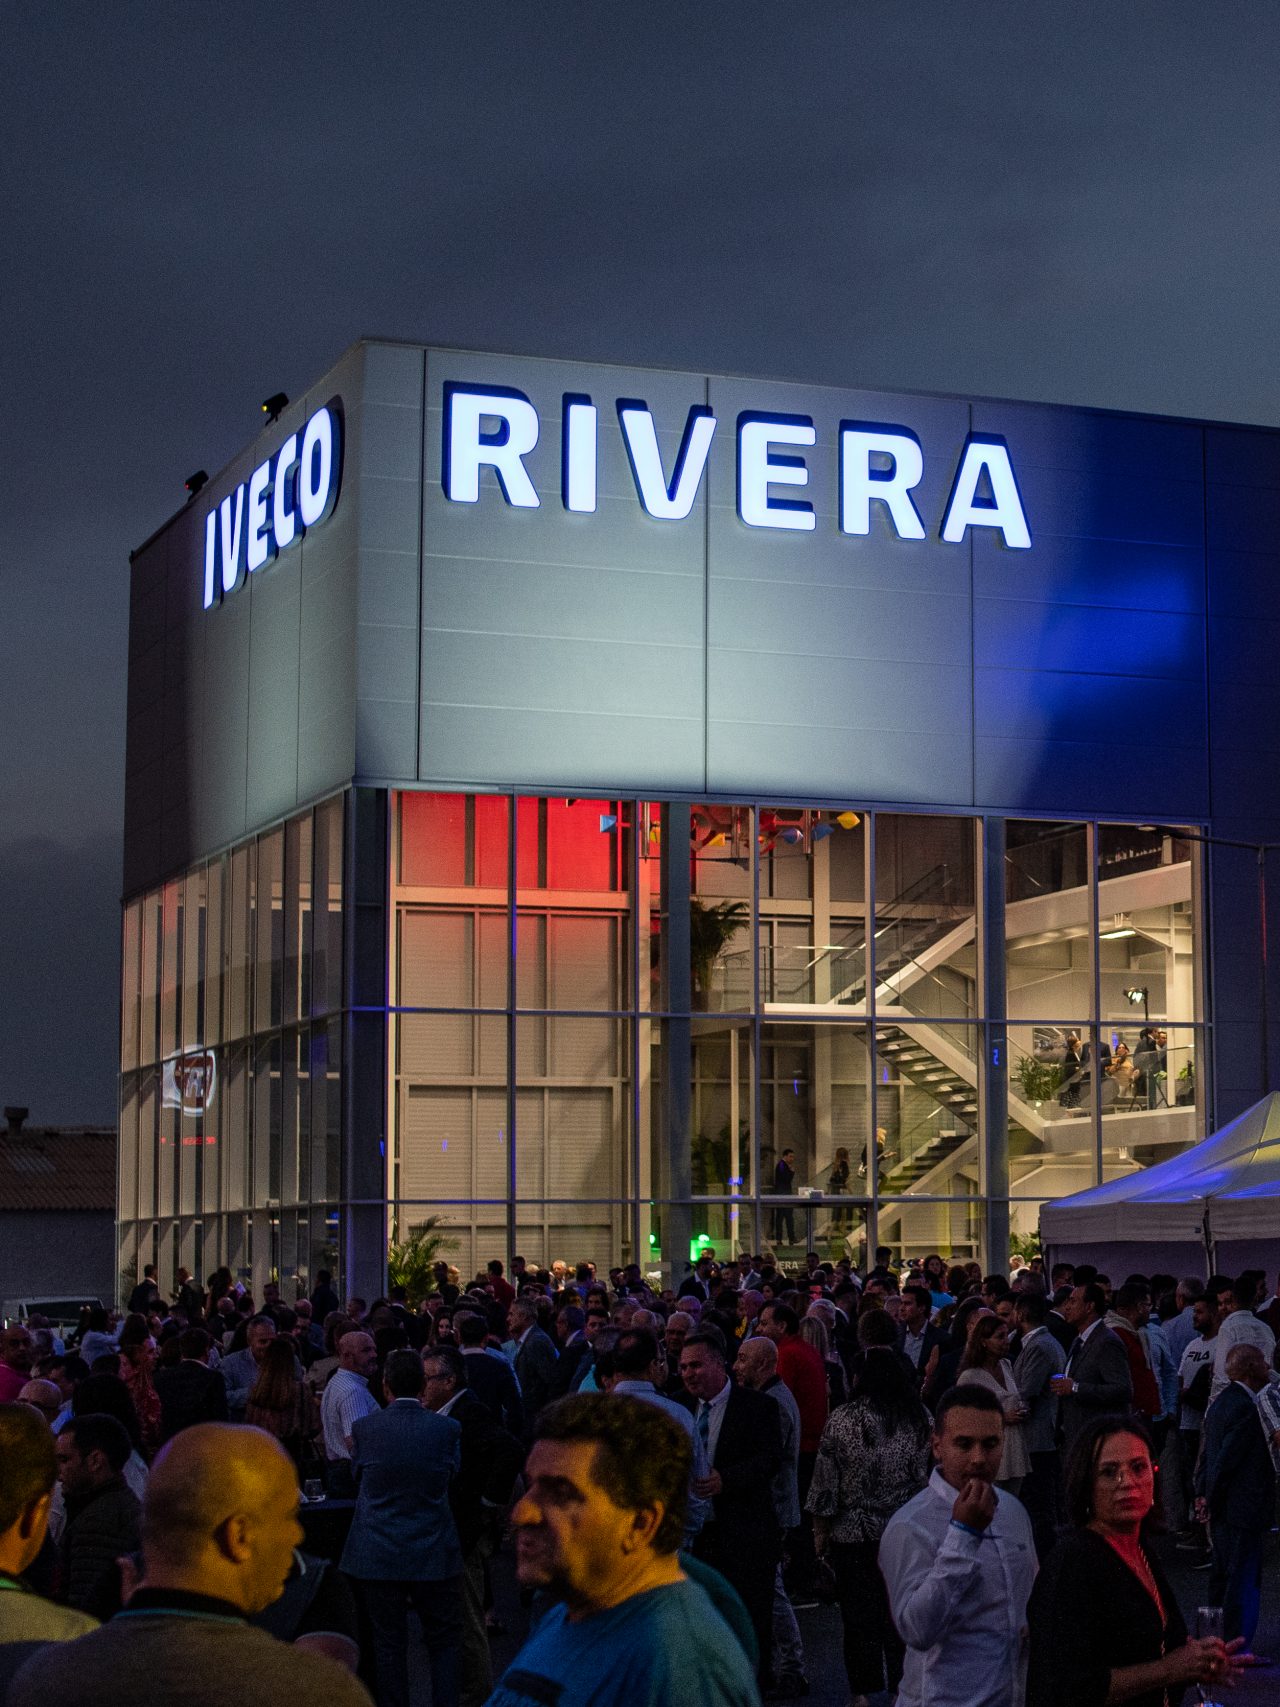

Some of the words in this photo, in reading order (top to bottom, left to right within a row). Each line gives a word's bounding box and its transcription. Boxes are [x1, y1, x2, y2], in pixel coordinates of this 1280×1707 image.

[203, 407, 334, 609] IVECO
[448, 391, 1032, 549] RIVERA
[1186, 1350, 1210, 1362] FILA
